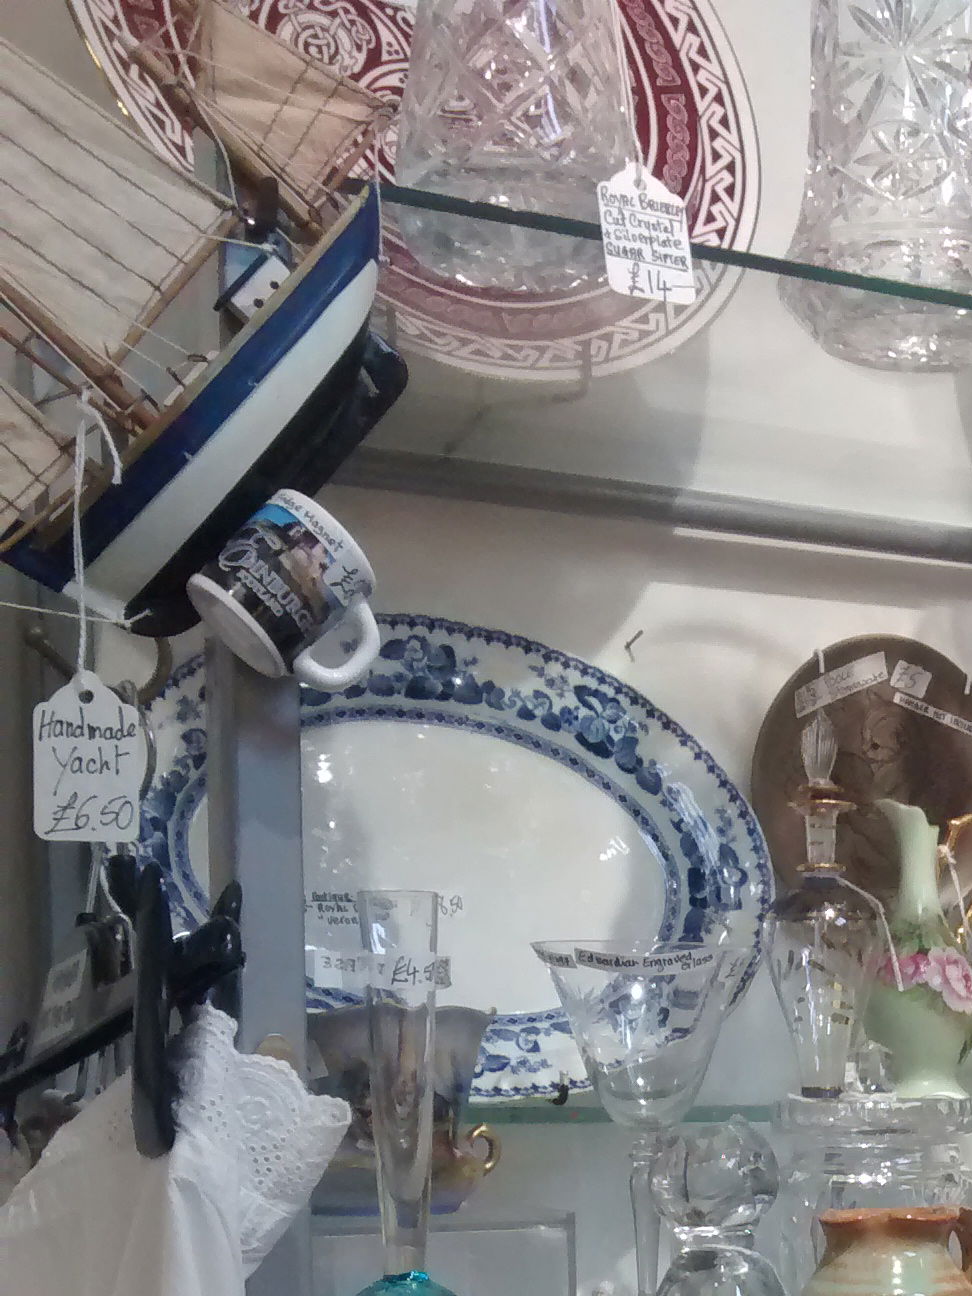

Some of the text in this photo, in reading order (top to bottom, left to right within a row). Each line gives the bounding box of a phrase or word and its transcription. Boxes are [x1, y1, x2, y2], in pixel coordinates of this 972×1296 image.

[38, 705, 137, 742] Handmade
[52, 744, 130, 796] Yacht
[44, 792, 134, 835] £6.50
